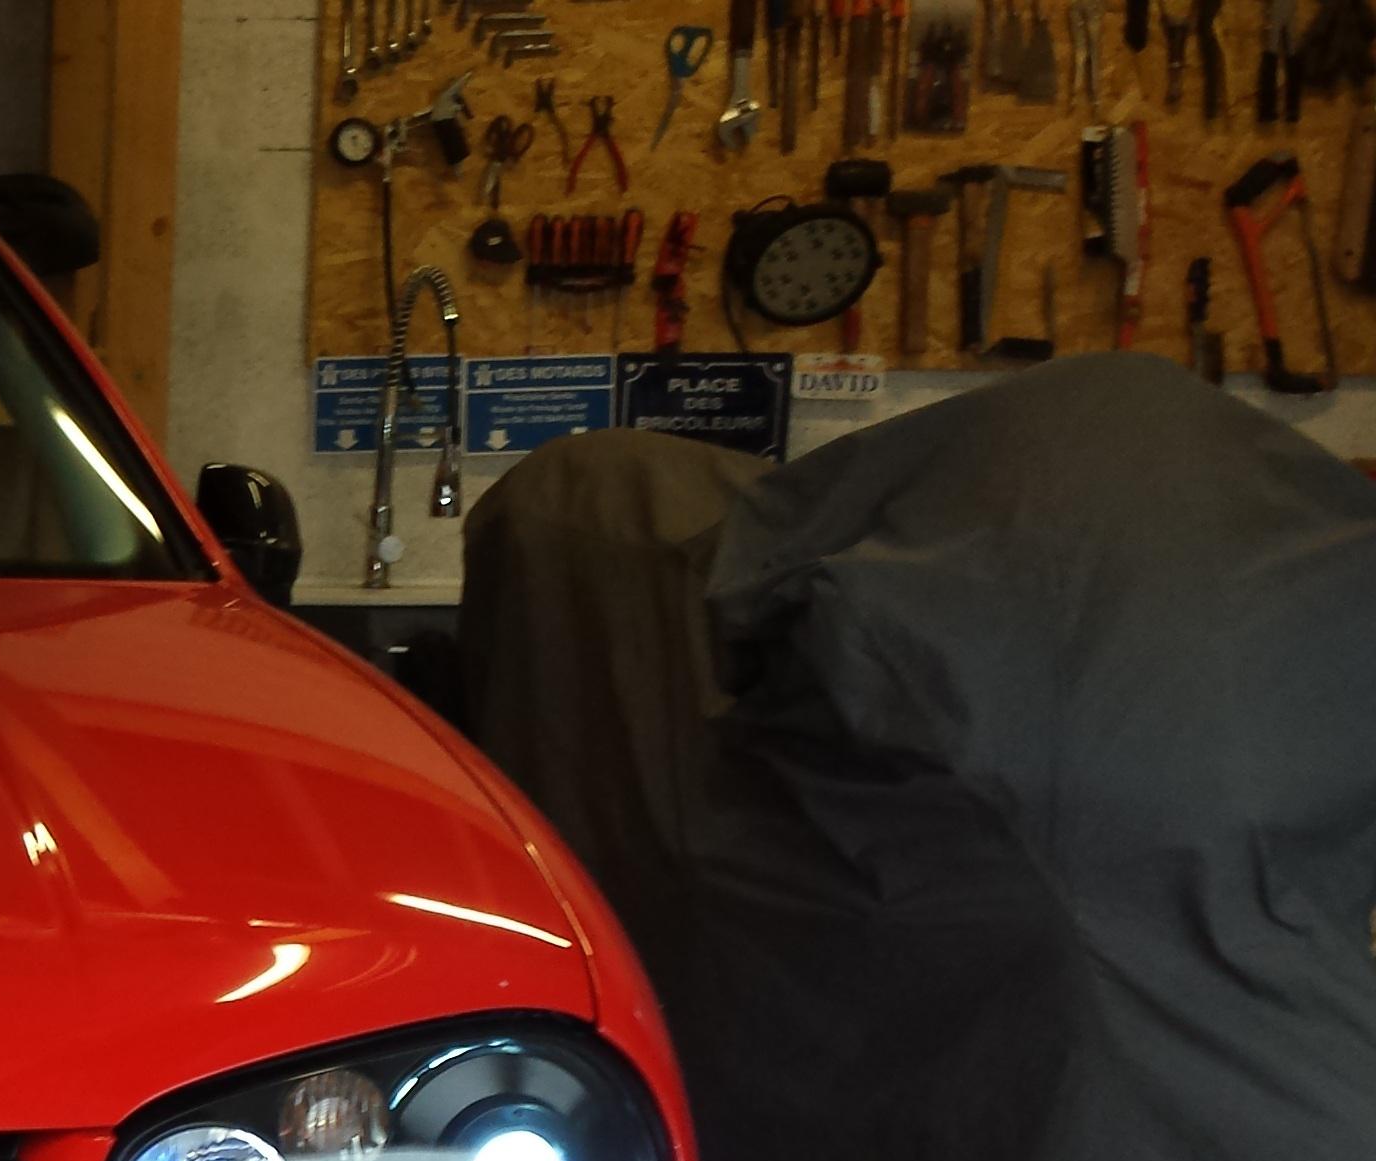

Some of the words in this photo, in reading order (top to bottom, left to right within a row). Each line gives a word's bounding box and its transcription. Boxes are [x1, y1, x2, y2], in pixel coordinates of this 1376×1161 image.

[495, 366, 529, 381] DES
[530, 364, 608, 380] MOTARDS
[667, 377, 742, 392] PLACE
[799, 373, 880, 392] DAVID
[683, 397, 725, 411] DES
